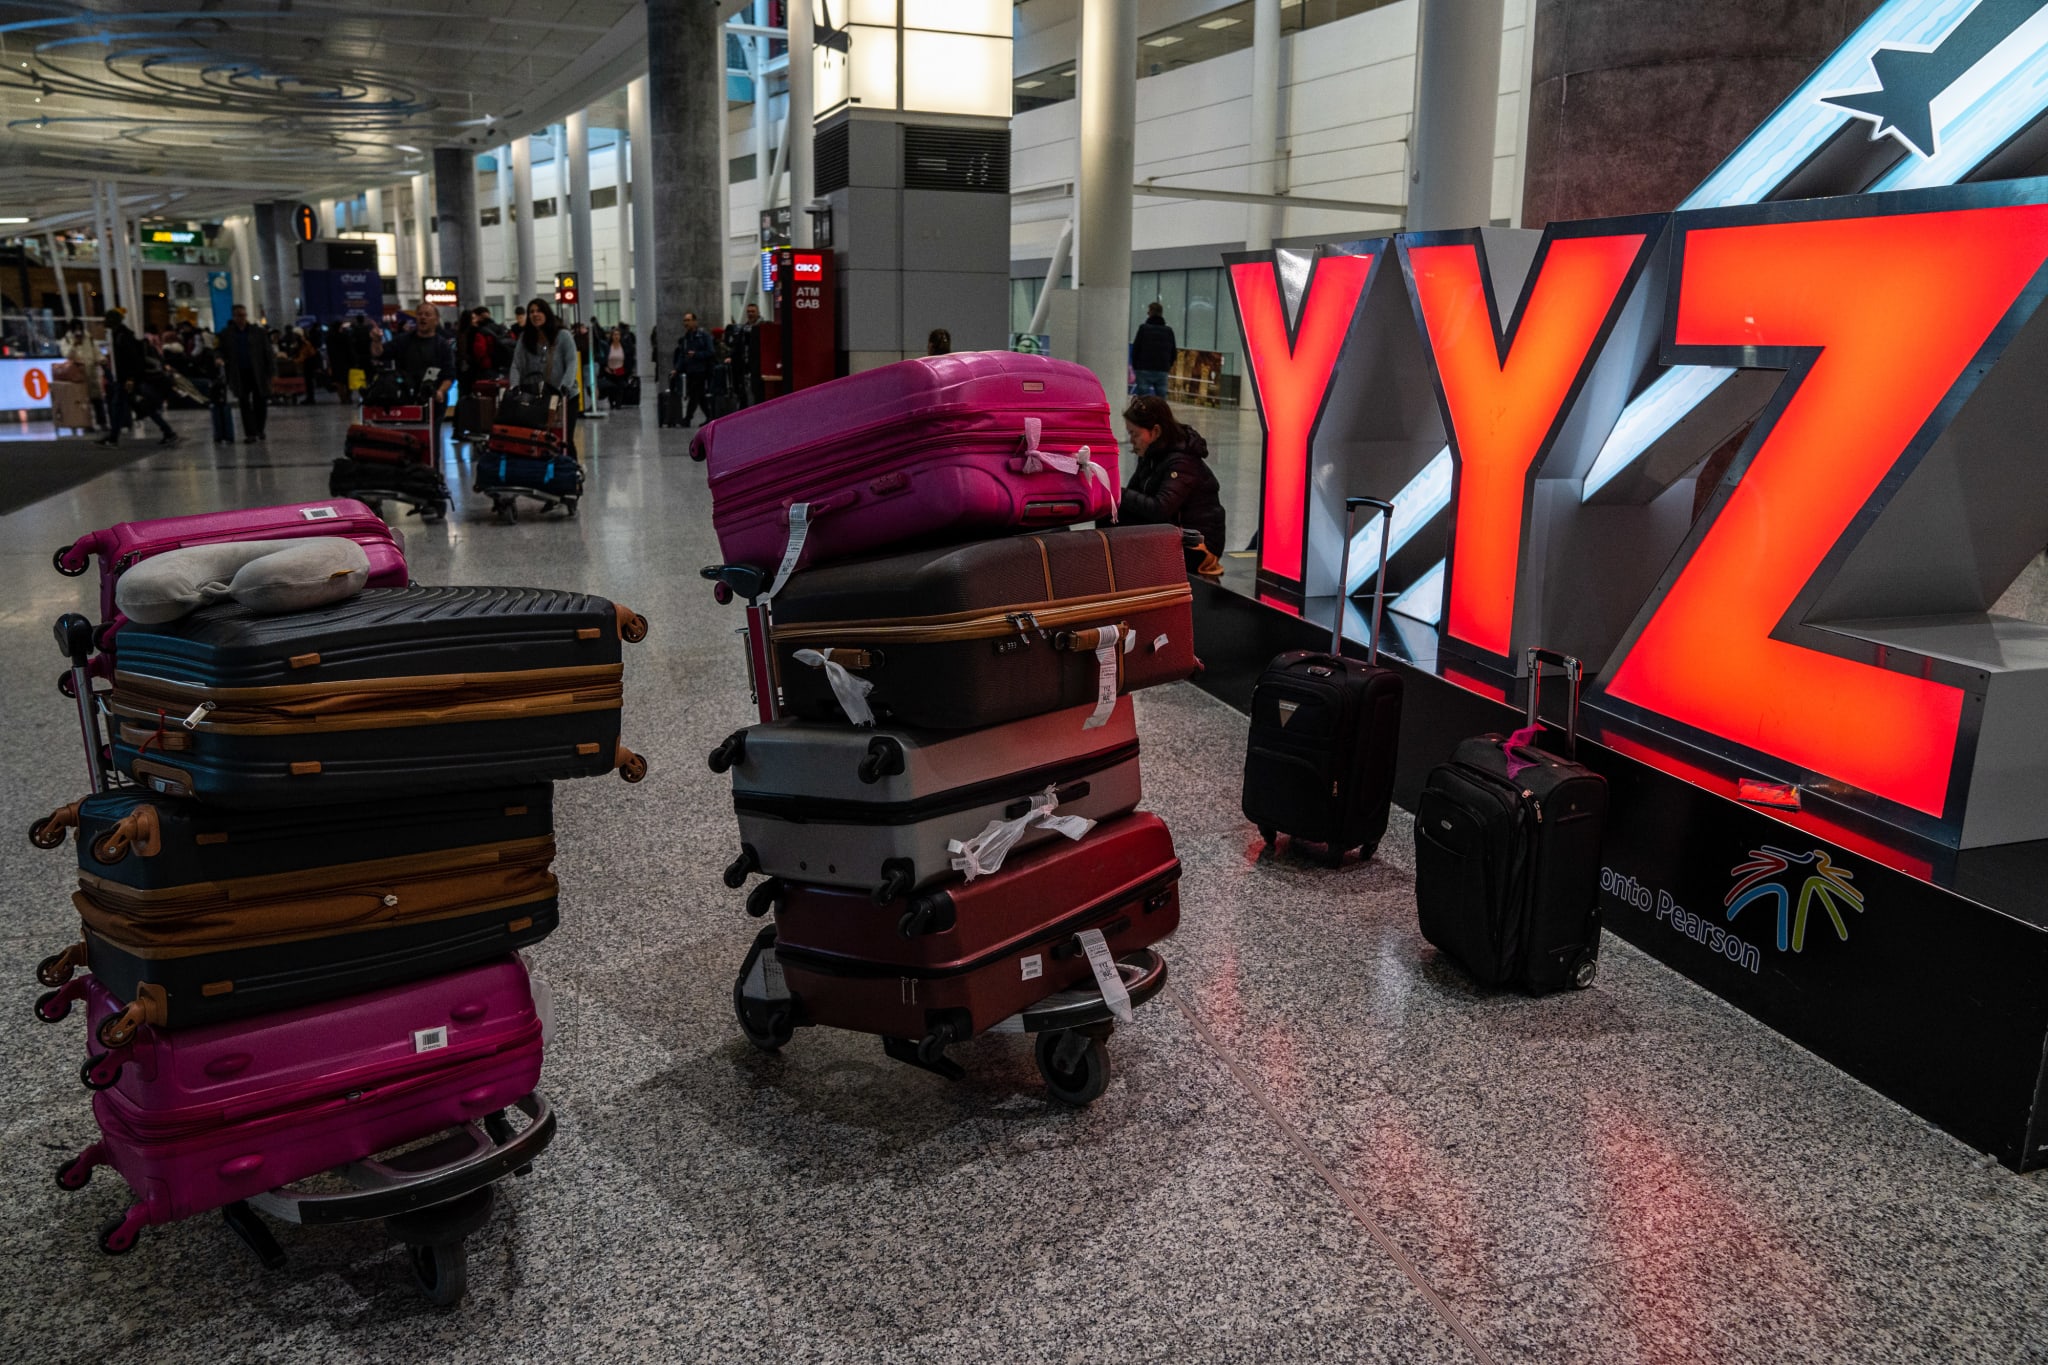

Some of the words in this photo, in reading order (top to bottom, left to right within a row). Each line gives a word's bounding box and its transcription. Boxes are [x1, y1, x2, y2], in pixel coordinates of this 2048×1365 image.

[795, 299, 820, 309] GAB
[796, 287, 820, 297] ATM
[1226, 200, 2048, 826] YYZ
[1600, 866, 1652, 912] onto
[1655, 888, 1760, 974] Pearson
